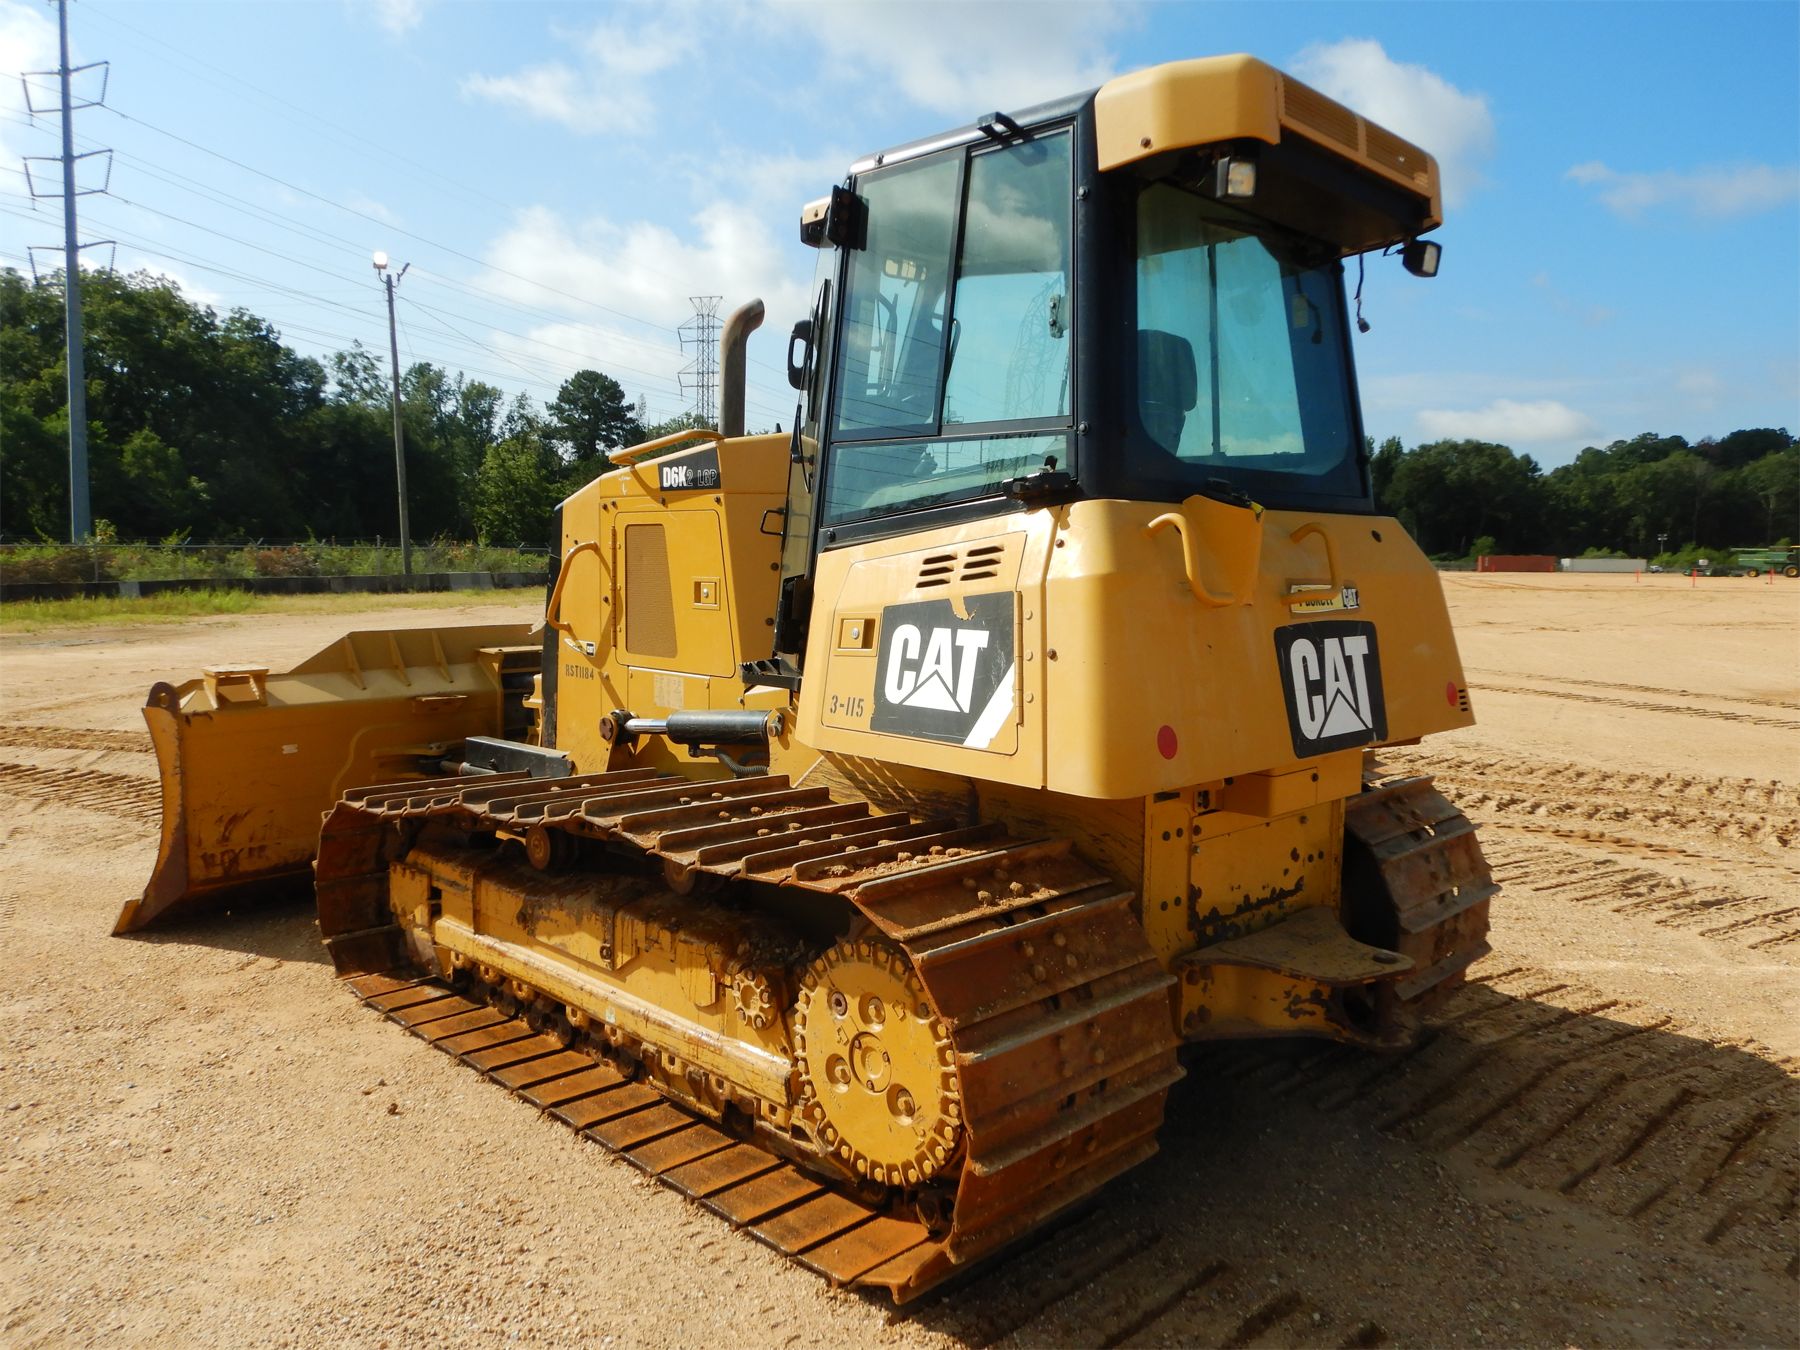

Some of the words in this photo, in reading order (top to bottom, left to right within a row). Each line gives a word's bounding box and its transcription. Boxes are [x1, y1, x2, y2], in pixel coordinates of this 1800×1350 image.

[662, 465, 694, 488] D6K2
[697, 468, 718, 487] LGP
[884, 623, 990, 714] CAT
[1290, 635, 1373, 740] CAT
[829, 694, 865, 718] 3-115
